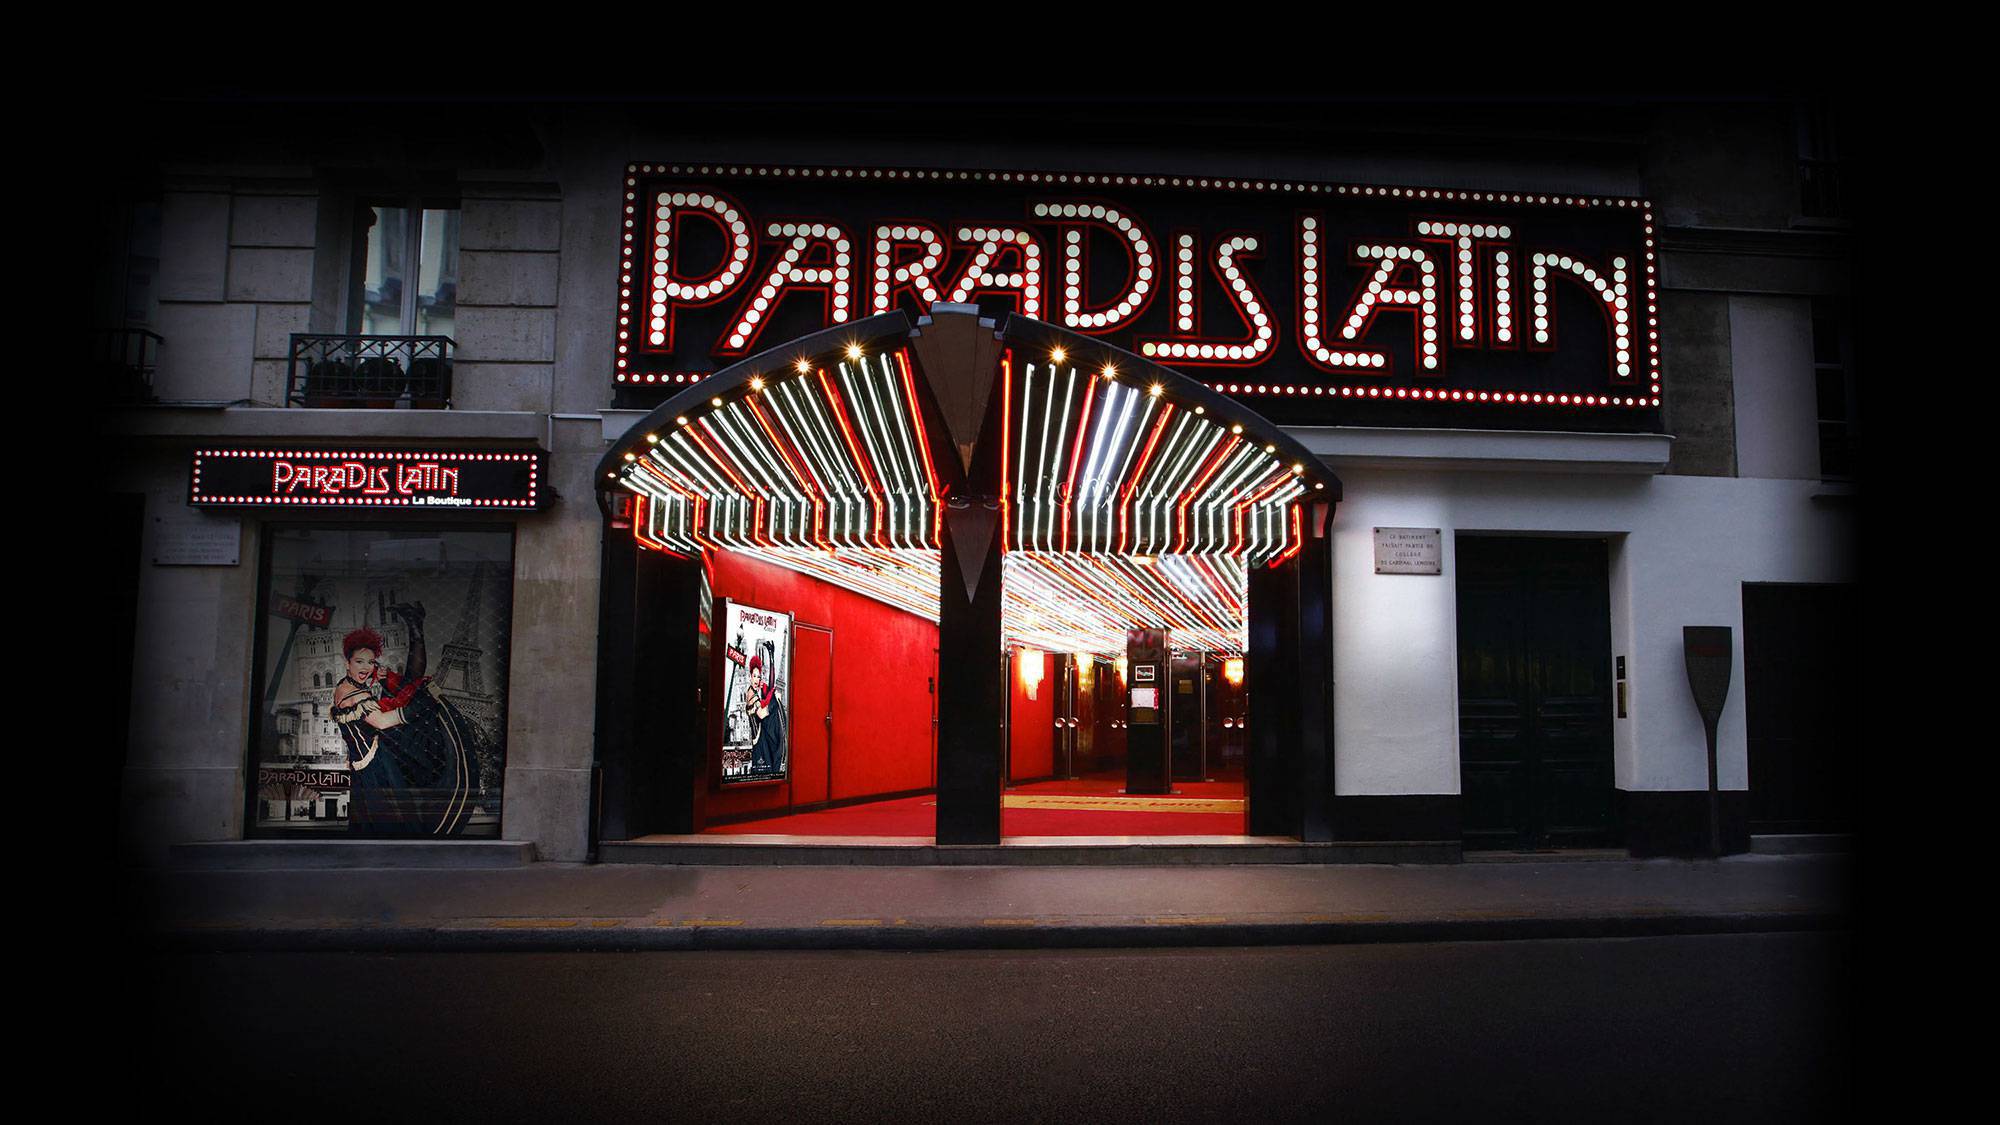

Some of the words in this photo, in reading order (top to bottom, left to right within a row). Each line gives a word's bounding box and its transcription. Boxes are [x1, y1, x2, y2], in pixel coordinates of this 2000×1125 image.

[644, 186, 1278, 364] PARADIS
[1297, 213, 1635, 382] LATIN
[273, 461, 389, 494] PARADIS
[396, 461, 459, 496] LATIN
[412, 496, 425, 505] La
[427, 496, 472, 507] Boutique
[280, 599, 325, 621] PARIS
[259, 769, 317, 785] PARADIS
[319, 771, 351, 787] LATIN
